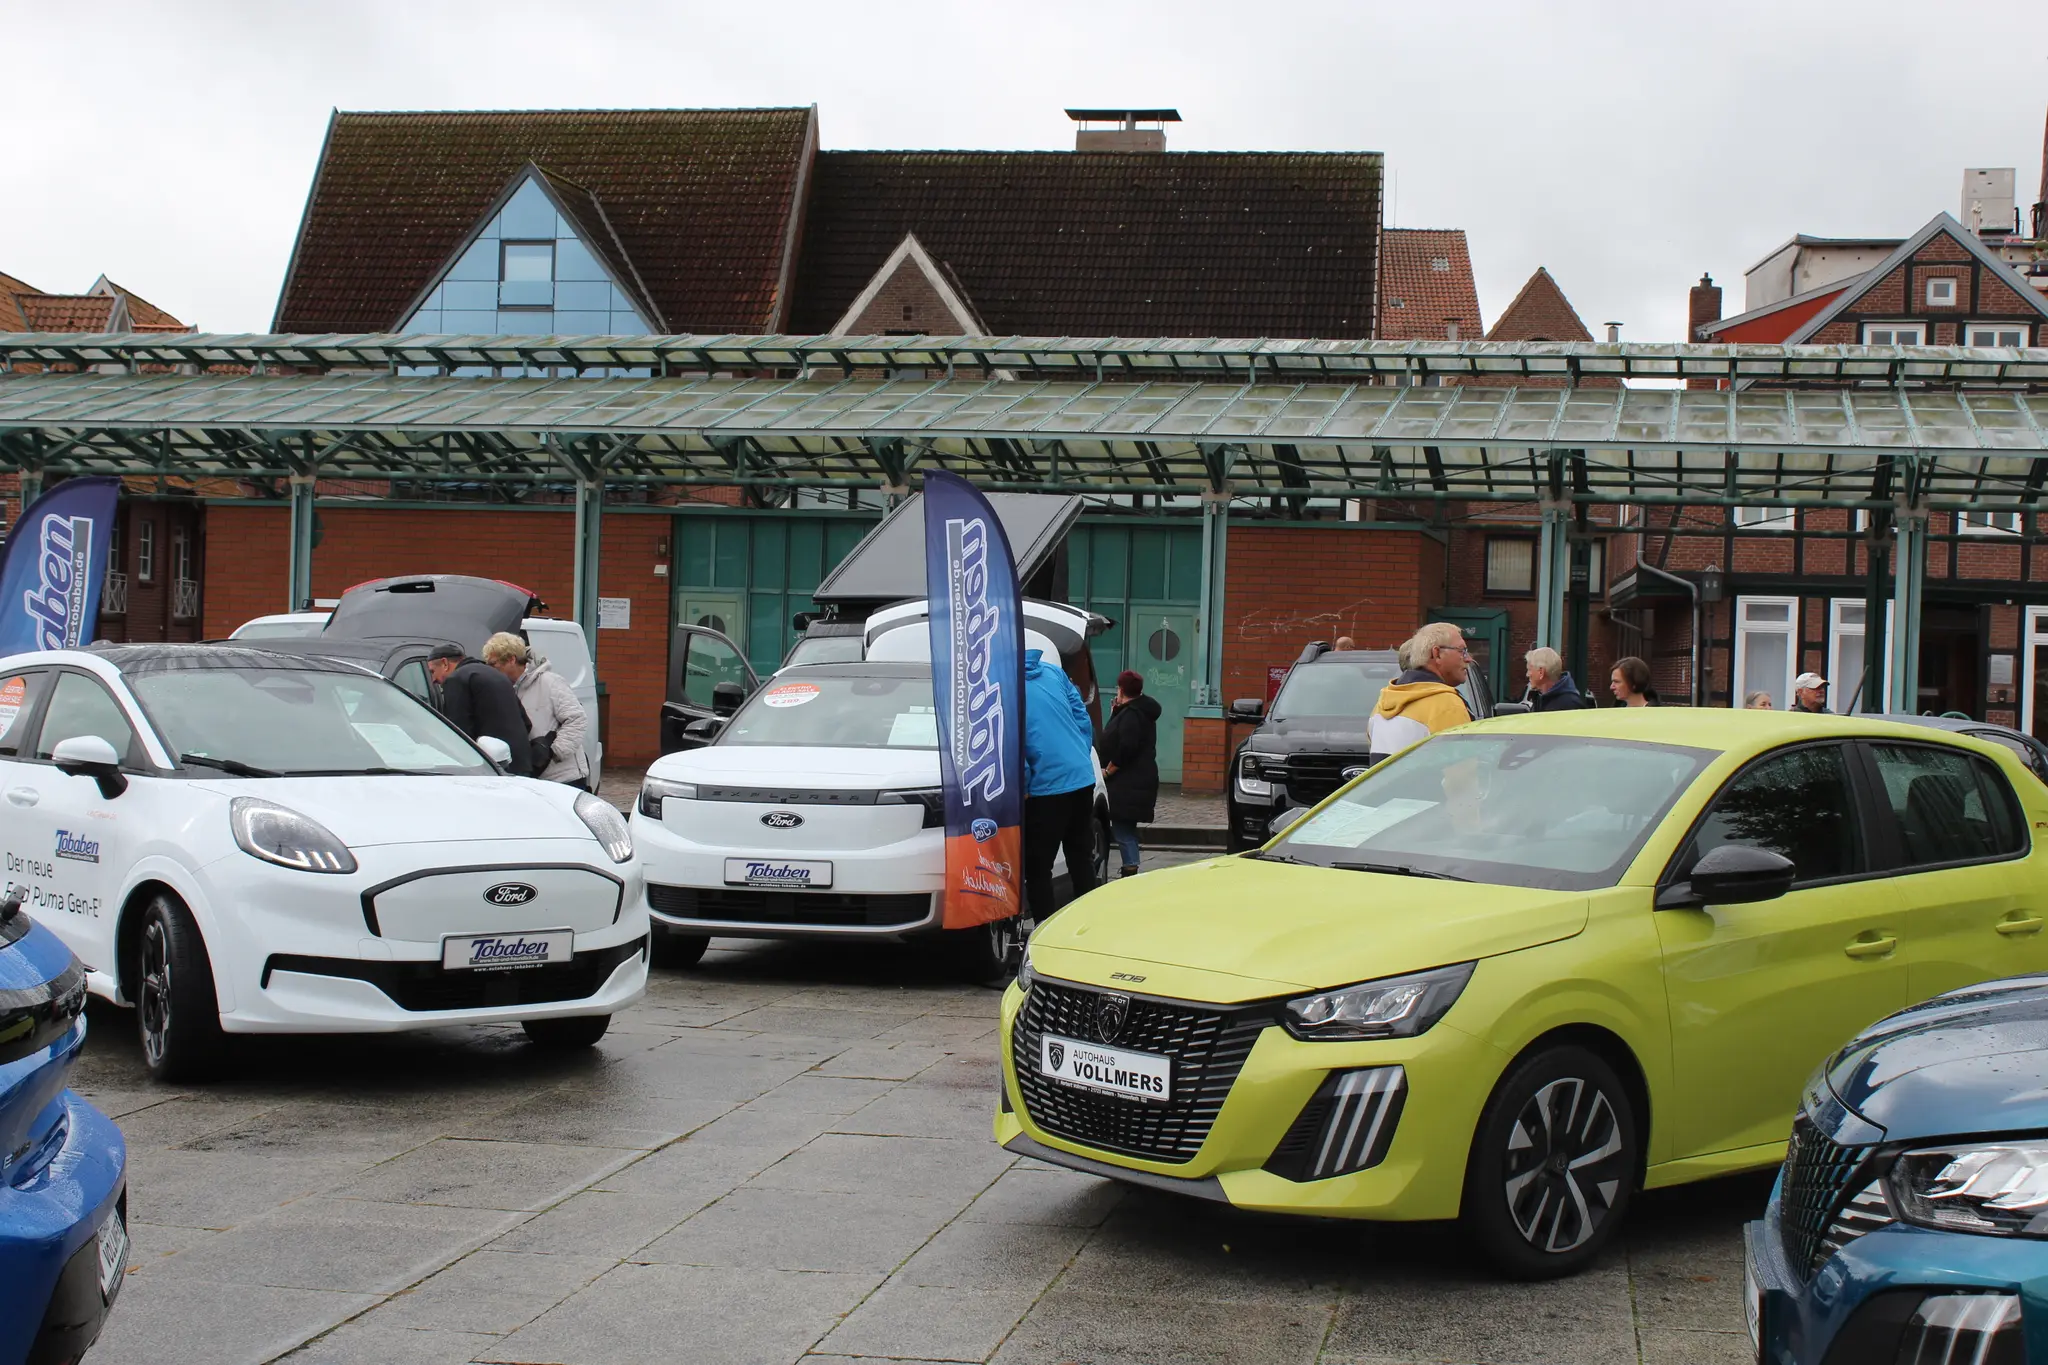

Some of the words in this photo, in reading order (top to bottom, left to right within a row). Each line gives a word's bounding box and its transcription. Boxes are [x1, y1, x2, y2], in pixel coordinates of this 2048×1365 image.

[768, 813, 796, 827] Ford
[55, 829, 99, 855] Tobaben
[7, 852, 24, 873] Der
[28, 859, 53, 879] neue
[746, 862, 811, 879] Tobaben
[4, 881, 31, 904] Fd
[32, 886, 65, 911] Puma
[494, 886, 528, 902] Ford
[471, 937, 549, 960] Tobaben
[474, 963, 543, 972] www.autohaus-tobaben.de
[1109, 972, 1147, 983] 208
[1073, 1049, 1116, 1066] AUTOHAUS
[1073, 1061, 1163, 1093] VOLLMERS
